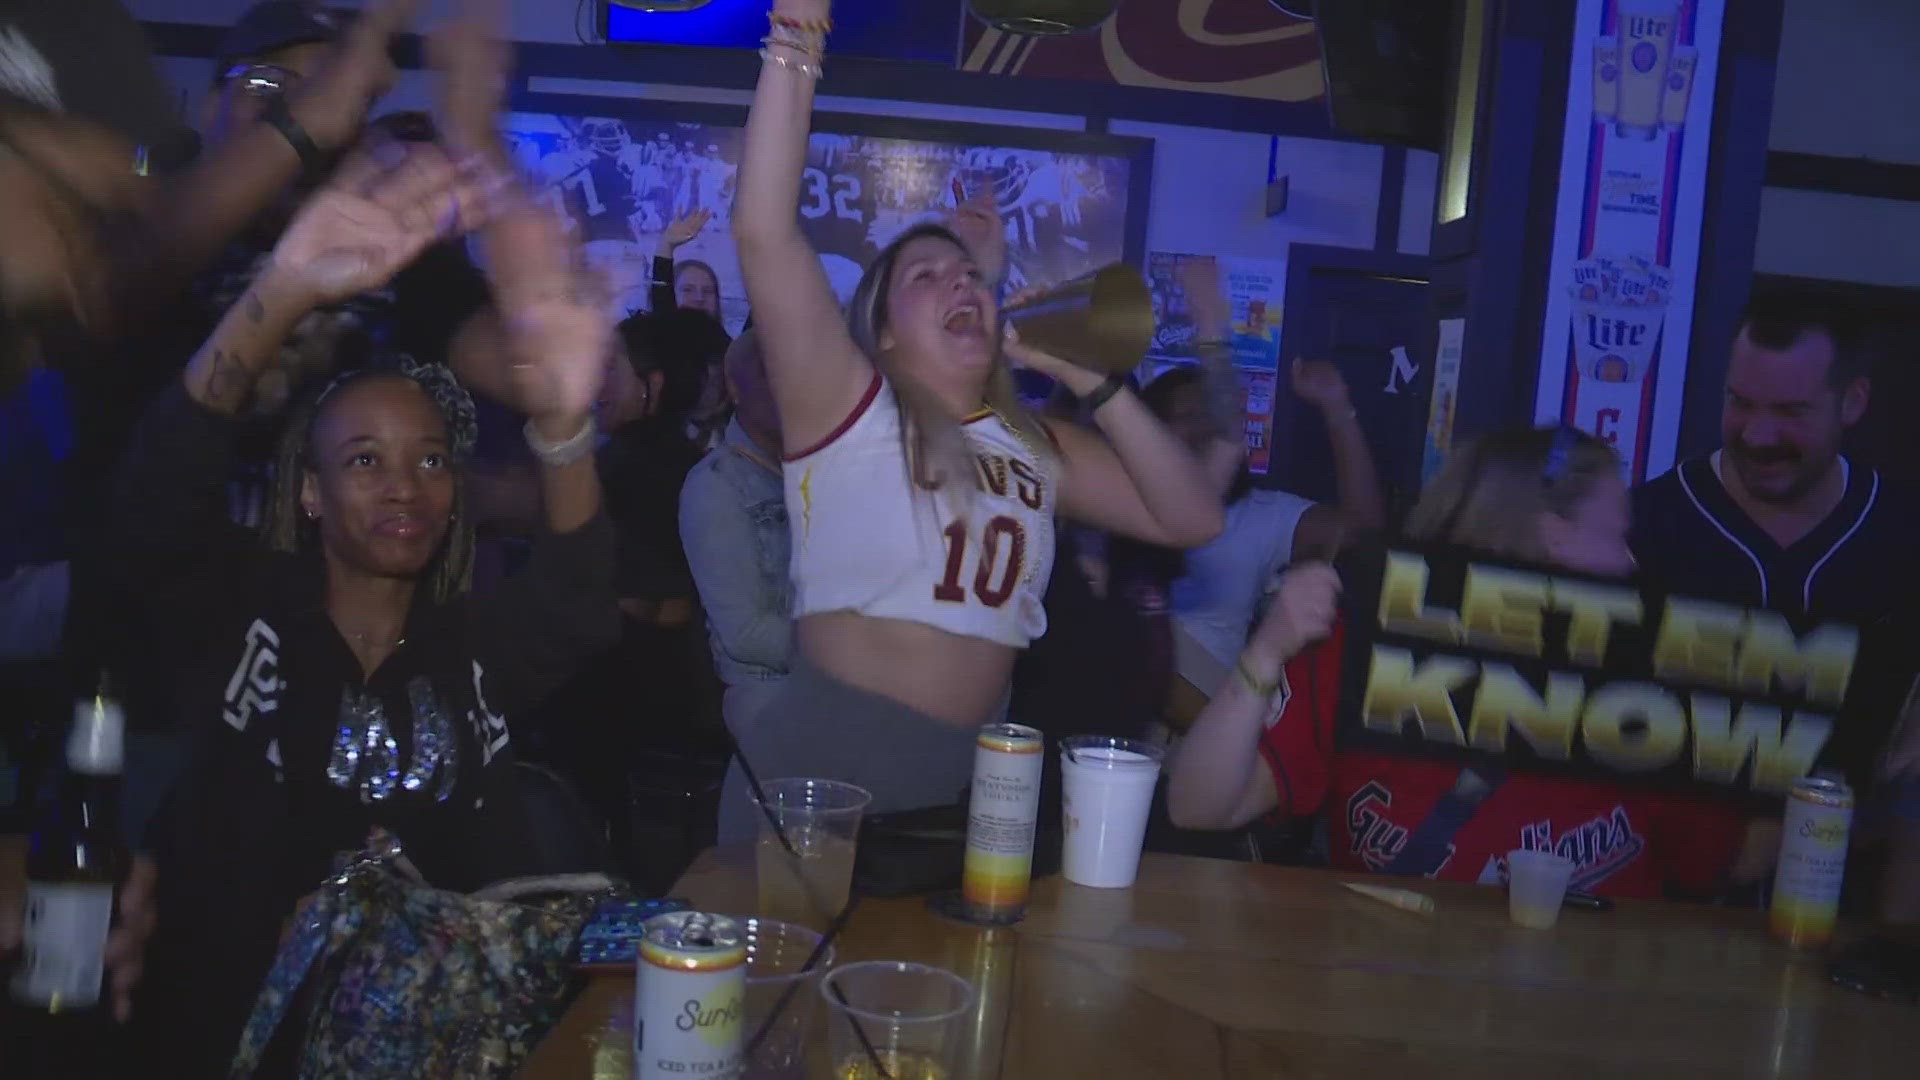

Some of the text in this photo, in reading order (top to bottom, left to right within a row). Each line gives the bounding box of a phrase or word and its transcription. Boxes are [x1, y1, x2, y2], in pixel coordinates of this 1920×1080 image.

[1630, 17, 1667, 39] Lite
[801, 167, 863, 224] 32
[1588, 314, 1646, 350] Lite
[934, 515, 1025, 608] 10
[1378, 549, 1860, 708] LET EM
[1363, 644, 1834, 791] KNOW
